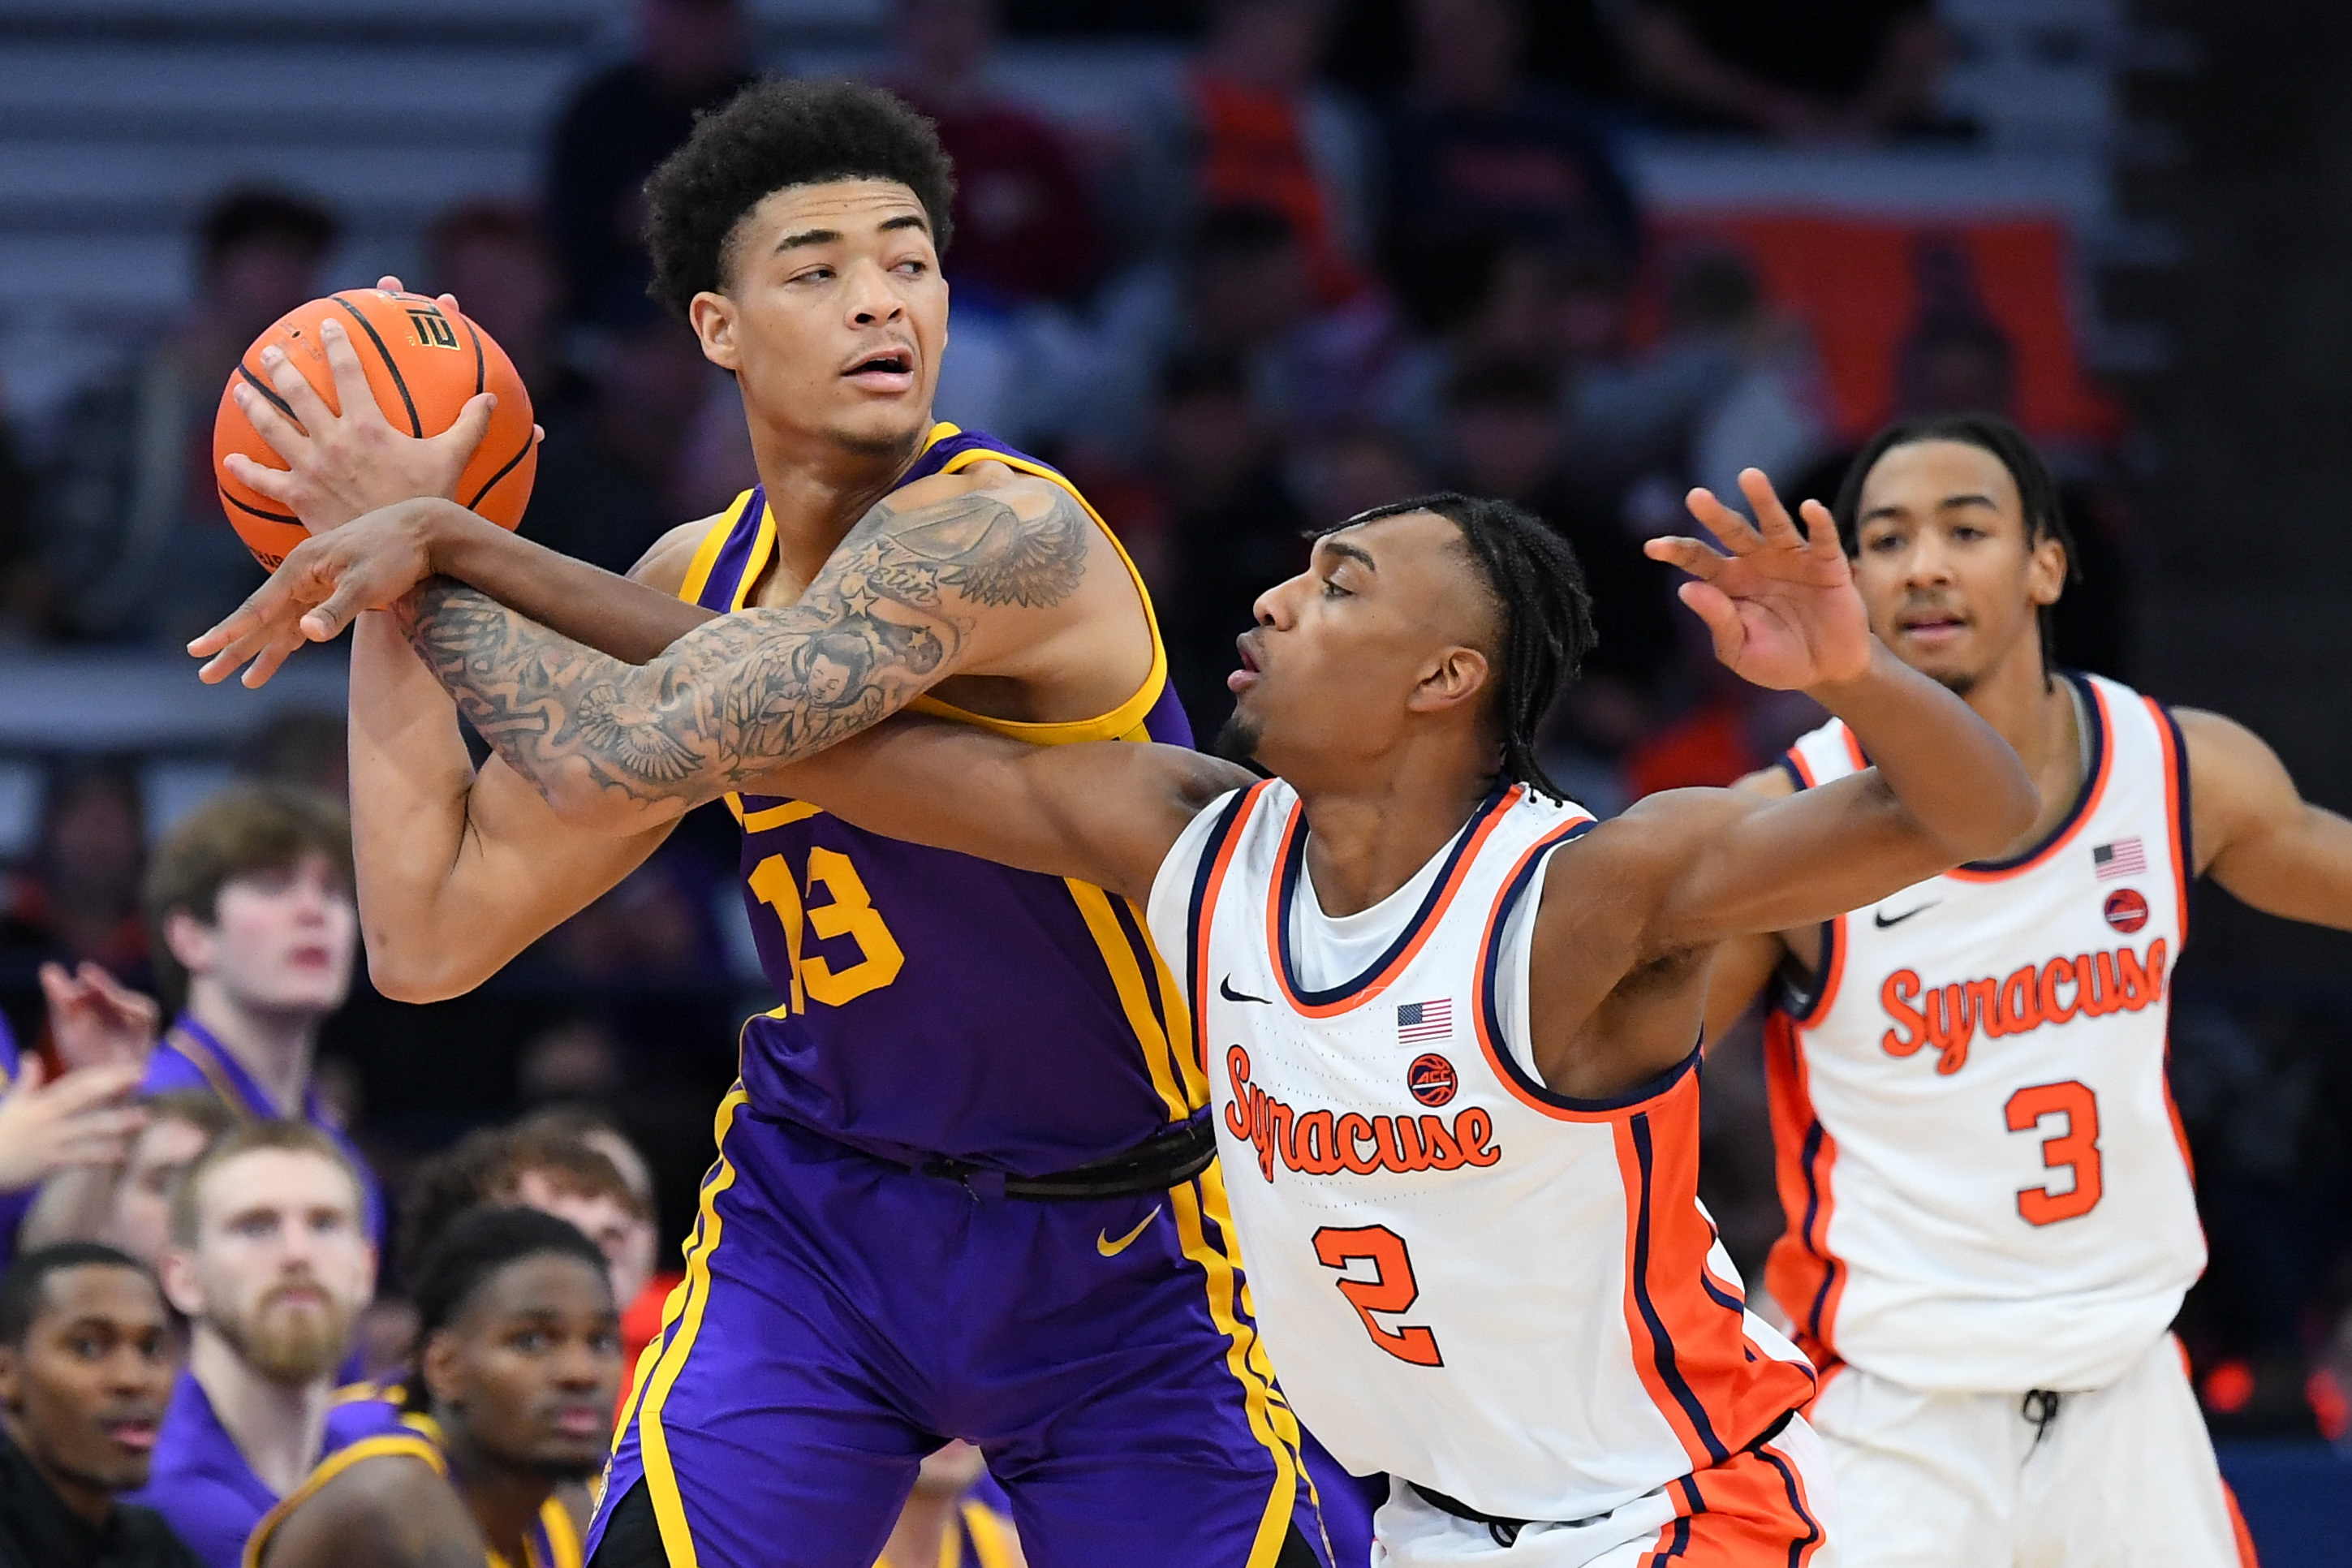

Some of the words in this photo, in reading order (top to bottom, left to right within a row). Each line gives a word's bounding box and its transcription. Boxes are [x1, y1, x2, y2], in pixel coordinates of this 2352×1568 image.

[747, 846, 905, 1014] 13
[1416, 1070, 1451, 1083] ACC
[1881, 937, 2166, 1076] Syracuse
[1225, 1045, 1501, 1184] Syracuse
[2005, 1079, 2102, 1226] 3
[1310, 1224, 1445, 1368] 2
